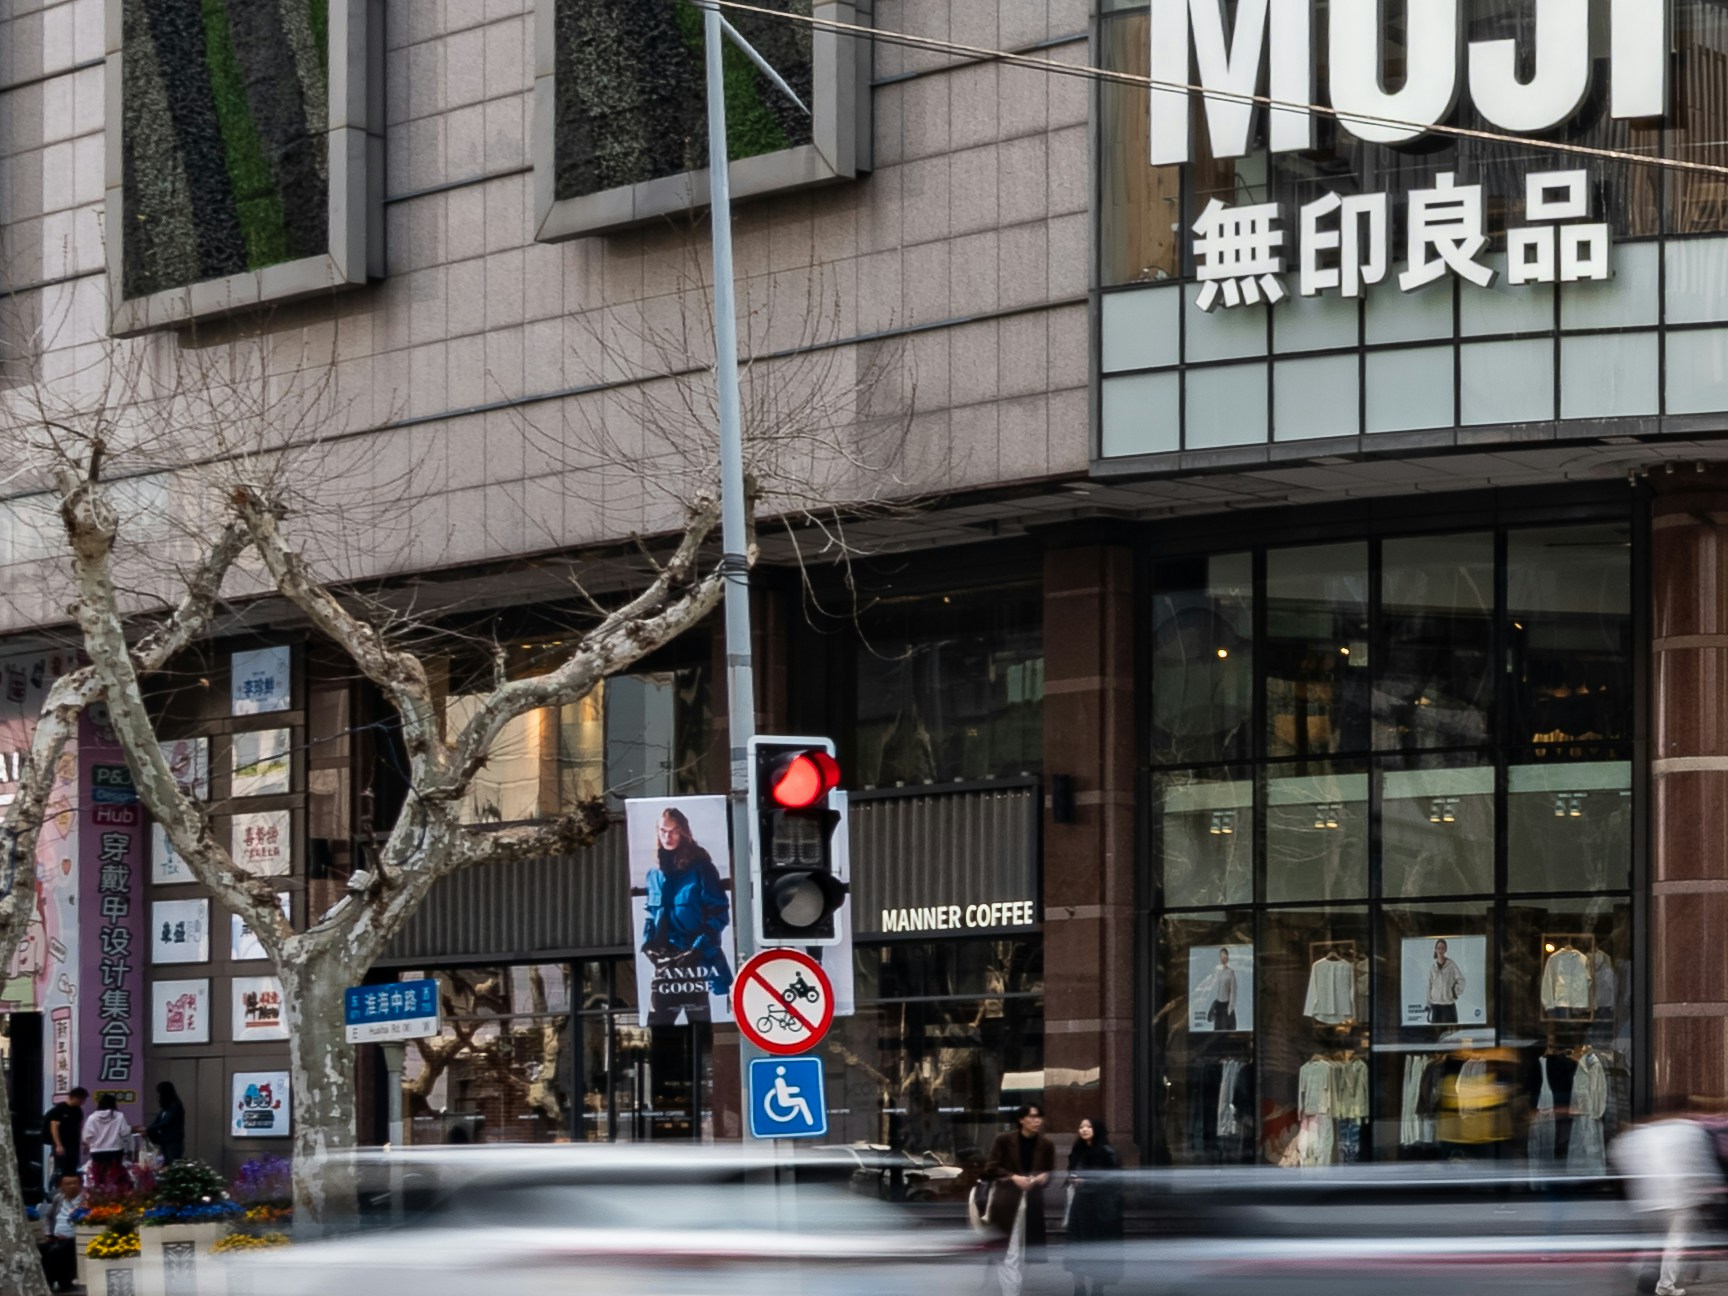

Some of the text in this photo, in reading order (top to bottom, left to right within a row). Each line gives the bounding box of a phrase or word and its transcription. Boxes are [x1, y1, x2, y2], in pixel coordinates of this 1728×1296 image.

[1192, 169, 1614, 313] 無印良品
[98, 807, 134, 823] Hub
[882, 901, 1034, 933] MANNER COFFEE
[100, 832, 131, 1082] 穿戴甲设计集合店
[659, 980, 715, 994] GOOSE
[364, 989, 417, 1017] 淮海中路
